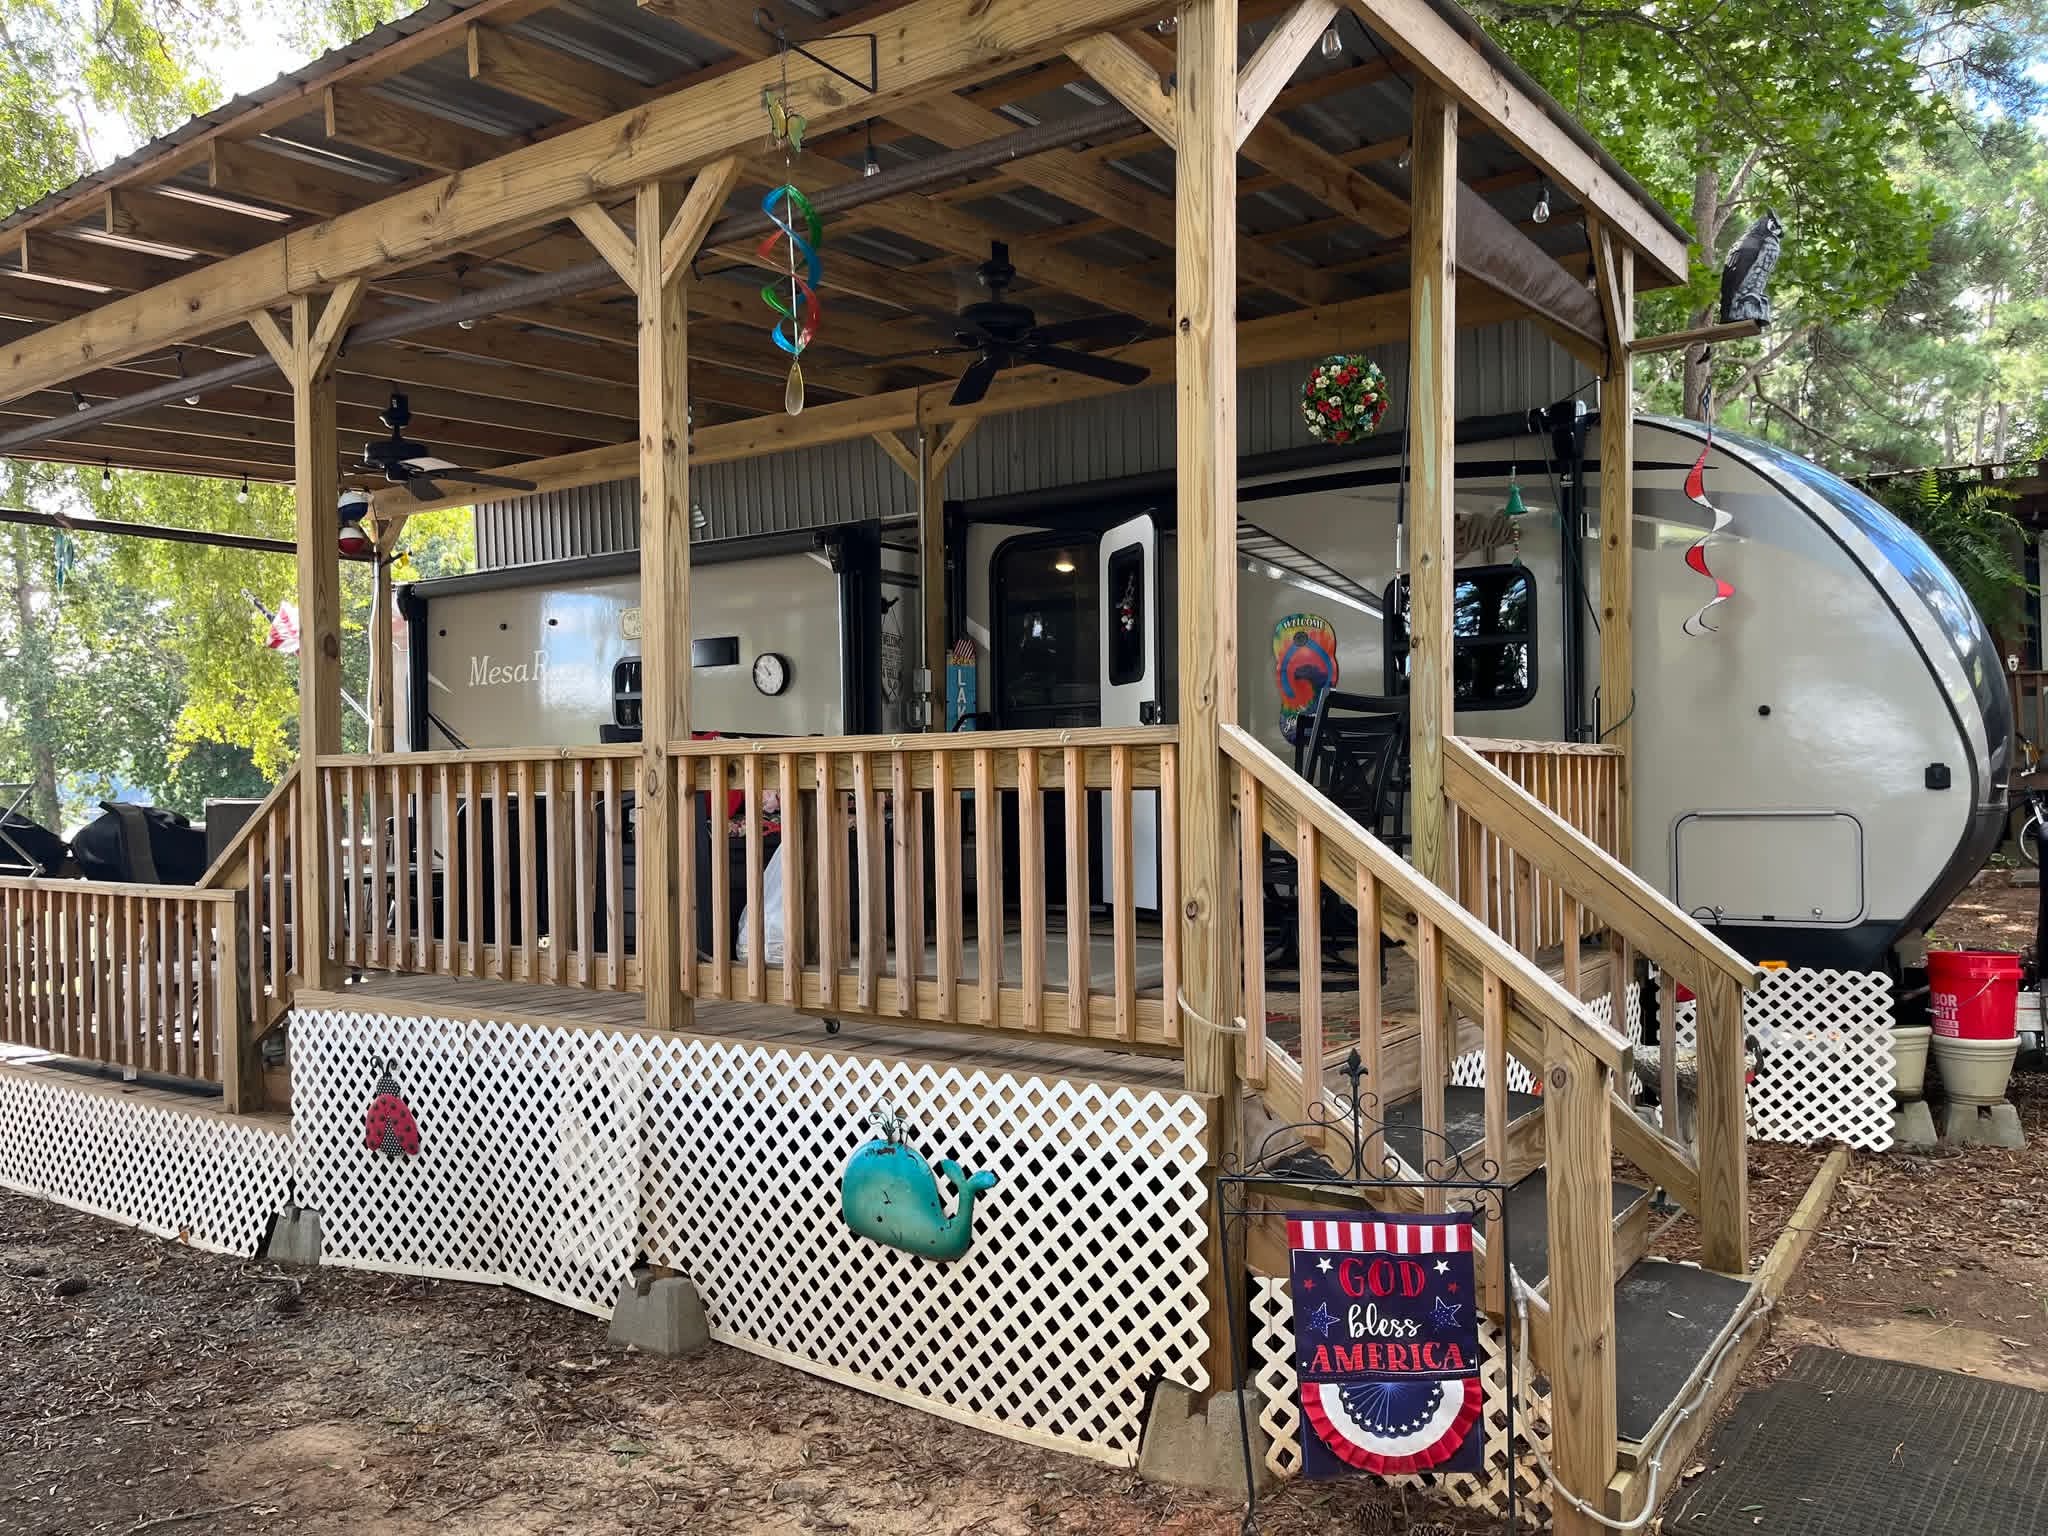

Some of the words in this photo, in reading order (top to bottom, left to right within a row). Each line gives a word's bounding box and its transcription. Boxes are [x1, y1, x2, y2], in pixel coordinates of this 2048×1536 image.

[1338, 1258, 1426, 1297] GOD
[1348, 1303, 1422, 1338] bless
[1308, 1342, 1466, 1373] AMERICA
